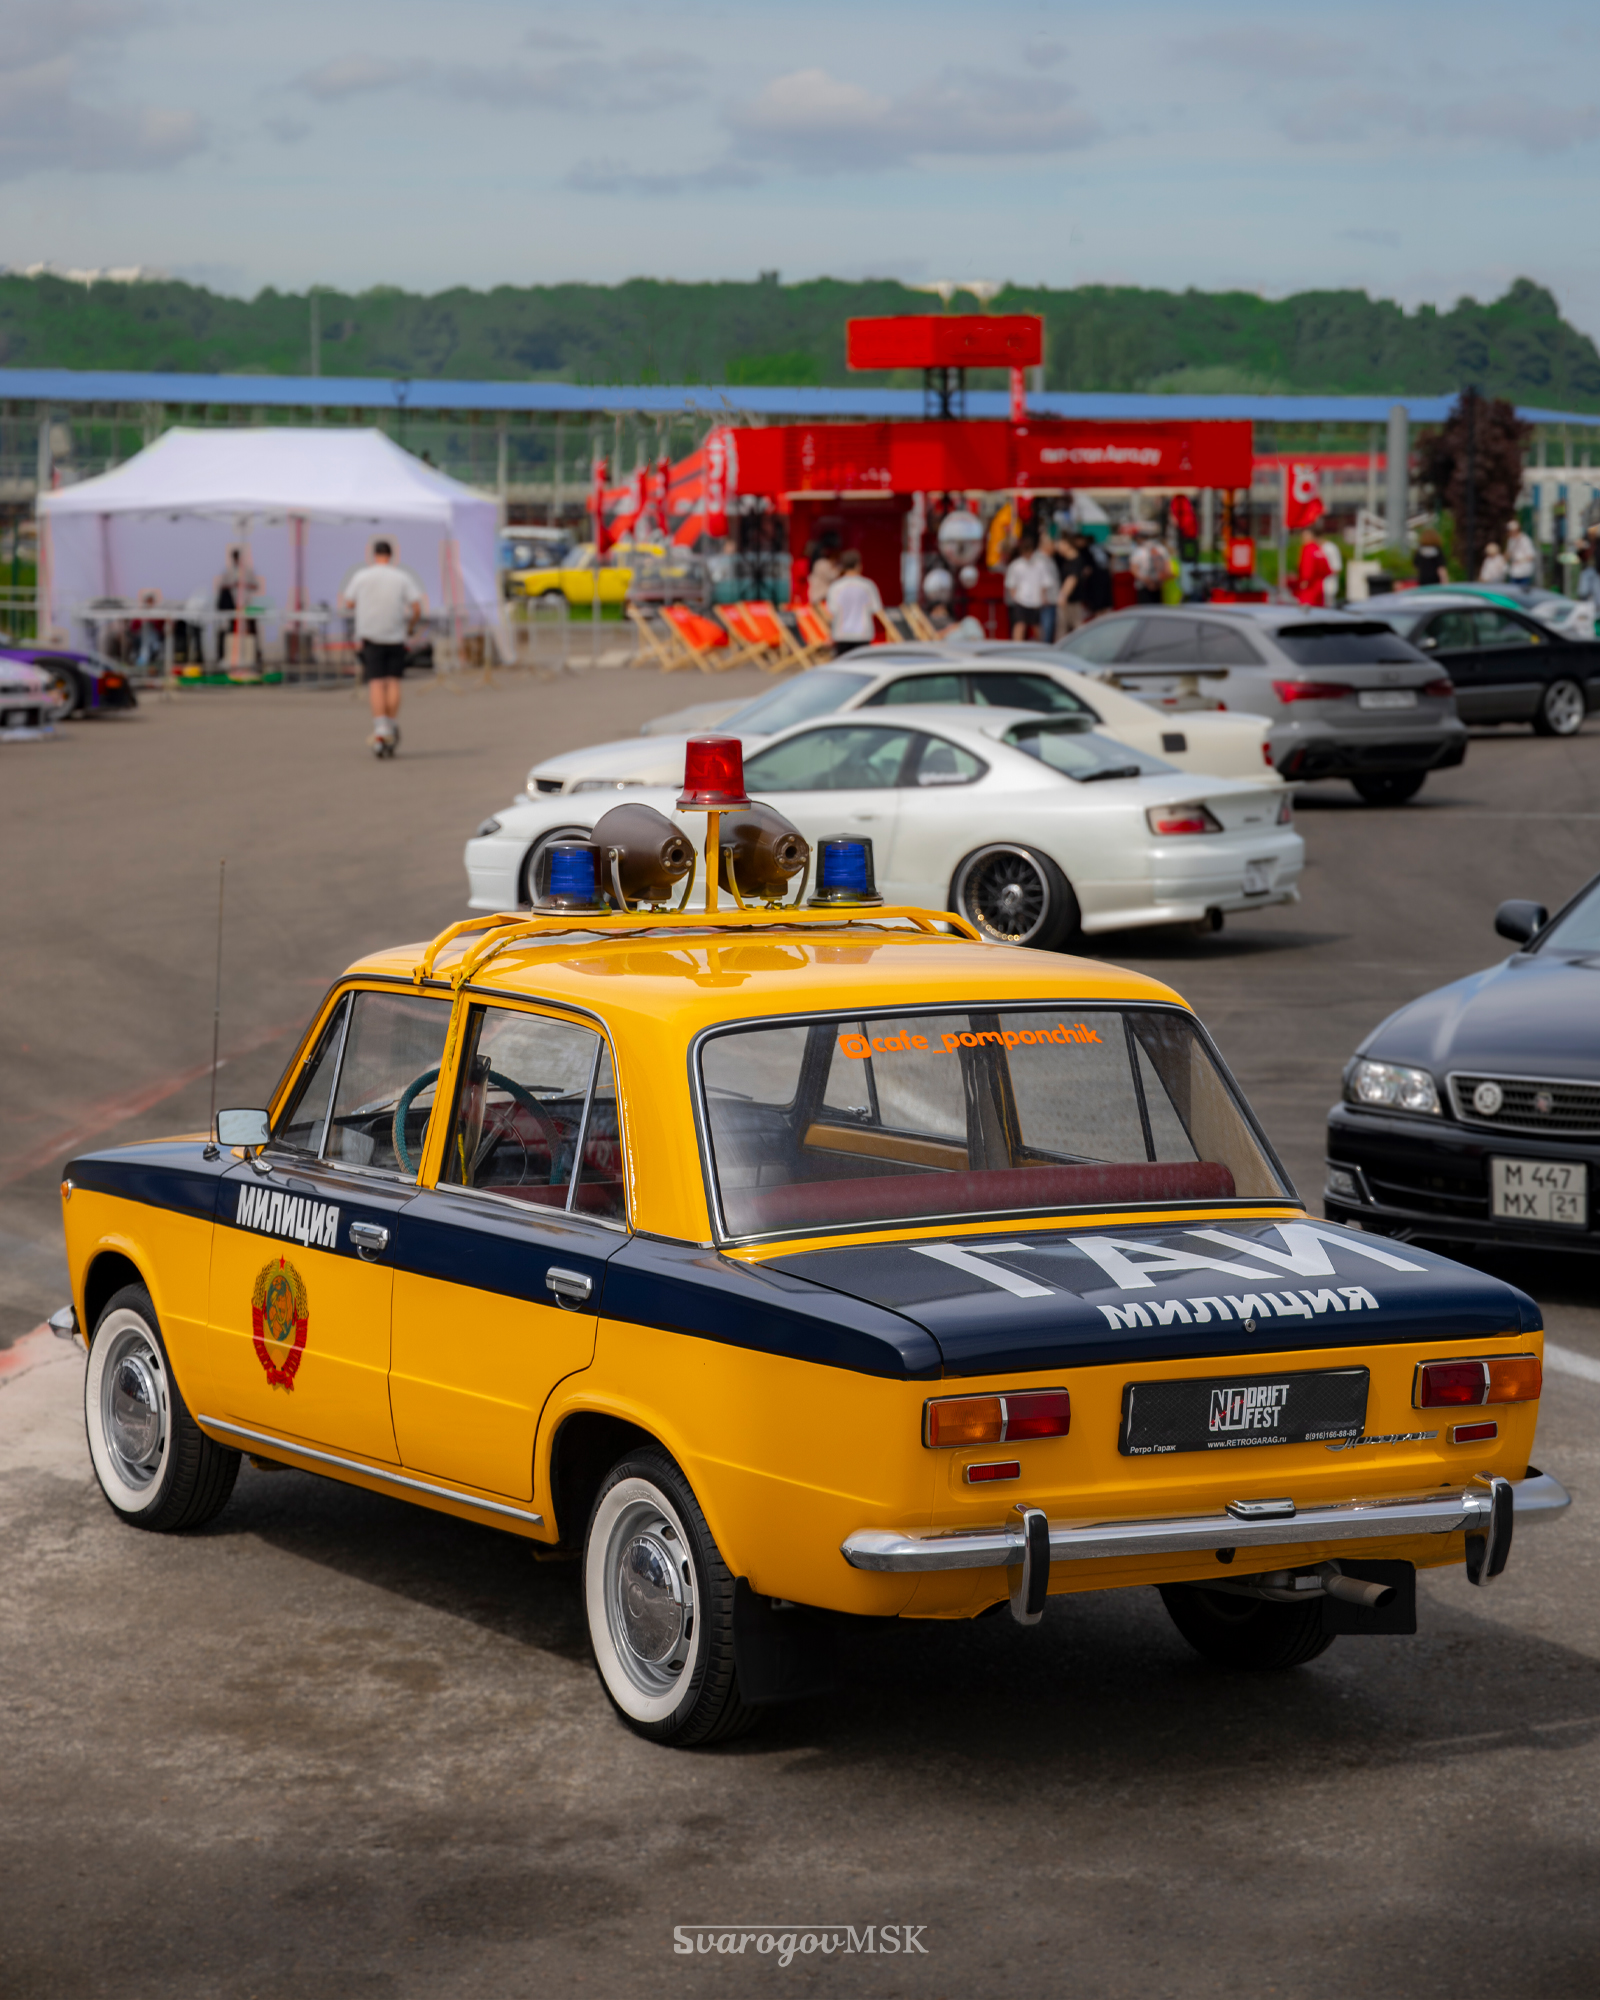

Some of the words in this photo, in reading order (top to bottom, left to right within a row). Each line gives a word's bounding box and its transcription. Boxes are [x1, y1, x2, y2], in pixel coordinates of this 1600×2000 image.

[1531, 1166, 1571, 1189] 447
[1556, 1196, 1577, 1213] 21
[236, 1184, 340, 1249] МИЛИЦИЯ
[908, 1223, 1429, 1298] ГАИ
[1096, 1285, 1380, 1330] МИЛИЦИЯ
[1247, 1384, 1290, 1408] DRIFT
[1245, 1406, 1281, 1429] FEST
[1130, 1446, 1152, 1454] Ретро
[1153, 1444, 1176, 1453] Гараж
[1207, 1436, 1287, 1449] www.RETROGARAG.ru
